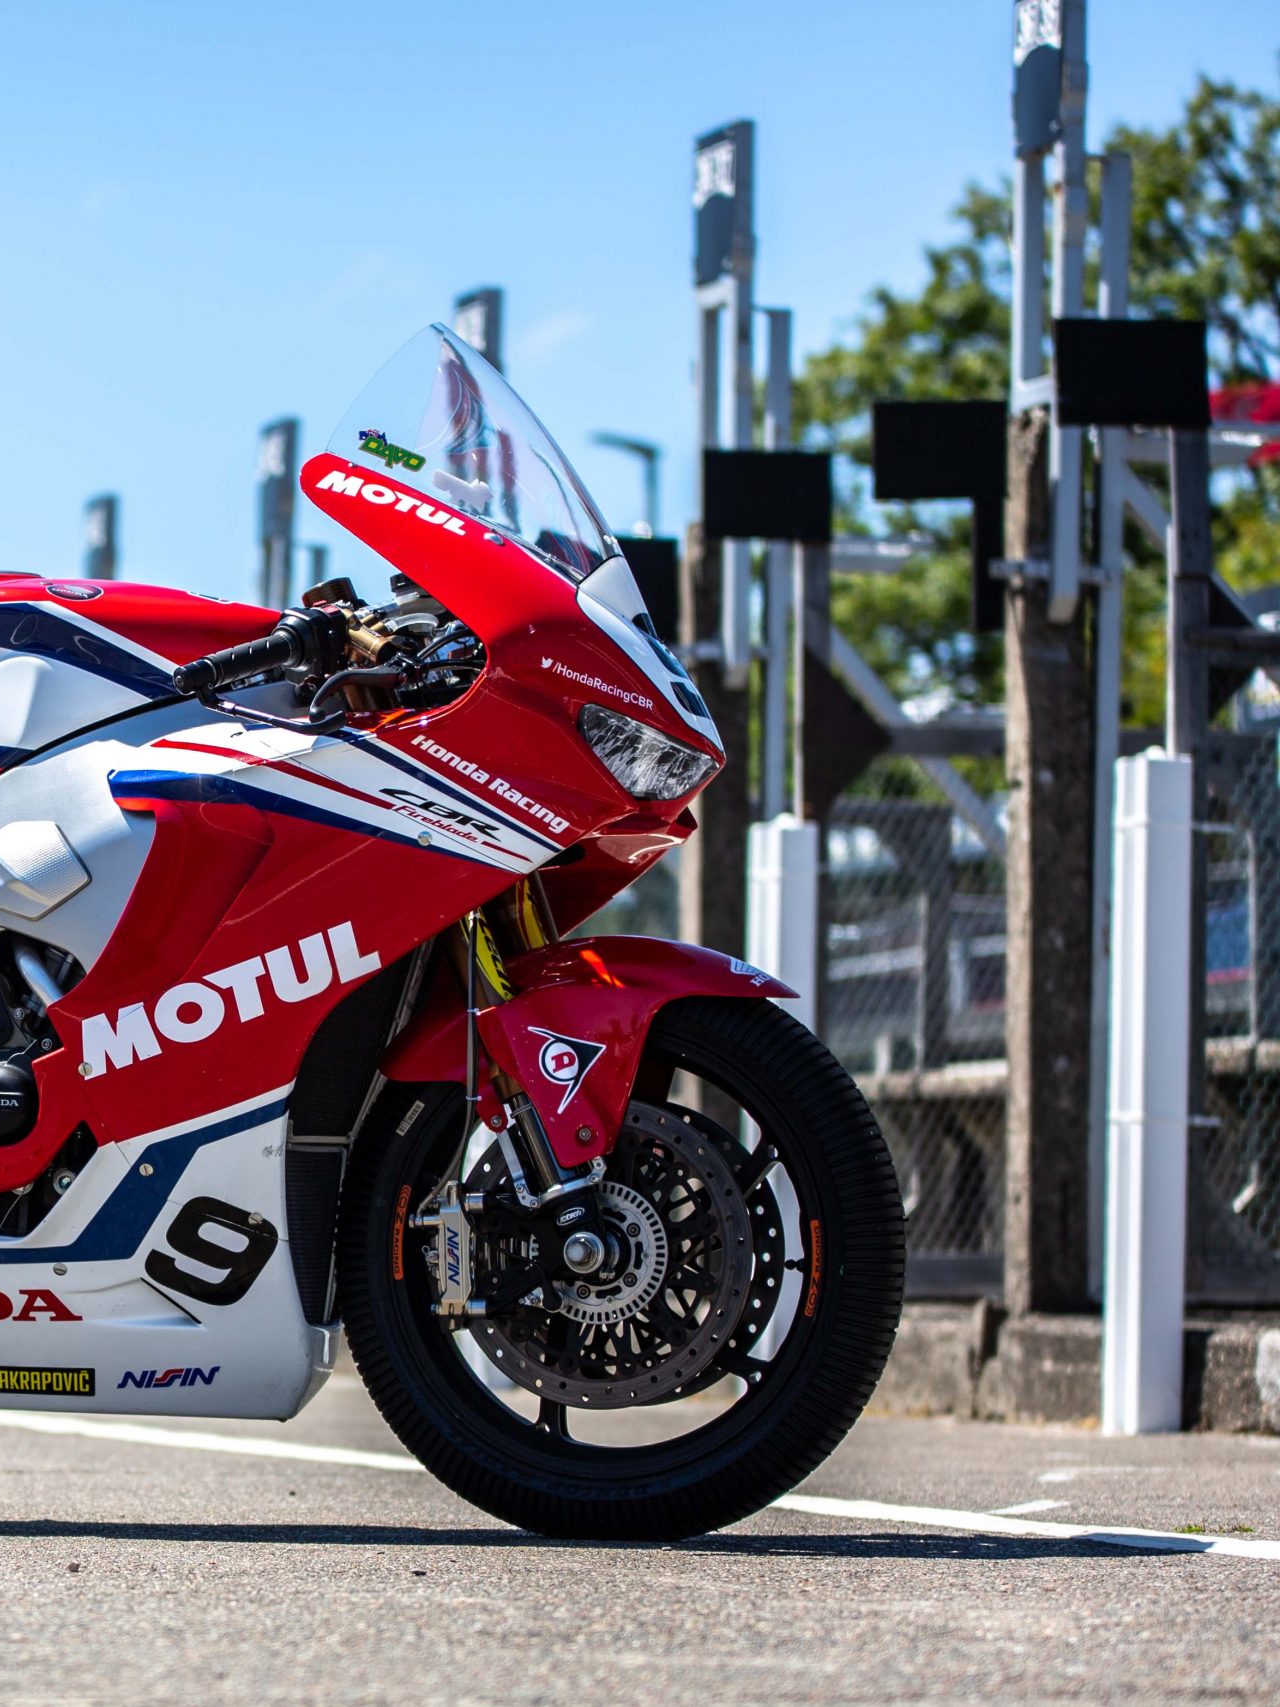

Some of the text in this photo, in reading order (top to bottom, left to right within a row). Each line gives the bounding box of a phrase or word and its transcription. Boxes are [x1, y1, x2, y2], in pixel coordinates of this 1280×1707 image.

[316, 470, 467, 536] MOTUL
[552, 661, 654, 711] /HondaRacingCBR
[410, 734, 570, 834] Honda Racing
[378, 788, 502, 842] CBR
[391, 805, 478, 843] Fireblade
[81, 920, 382, 1080] MOTUL
[145, 1196, 279, 1306] 9
[116, 1366, 222, 1389] NISSIN
